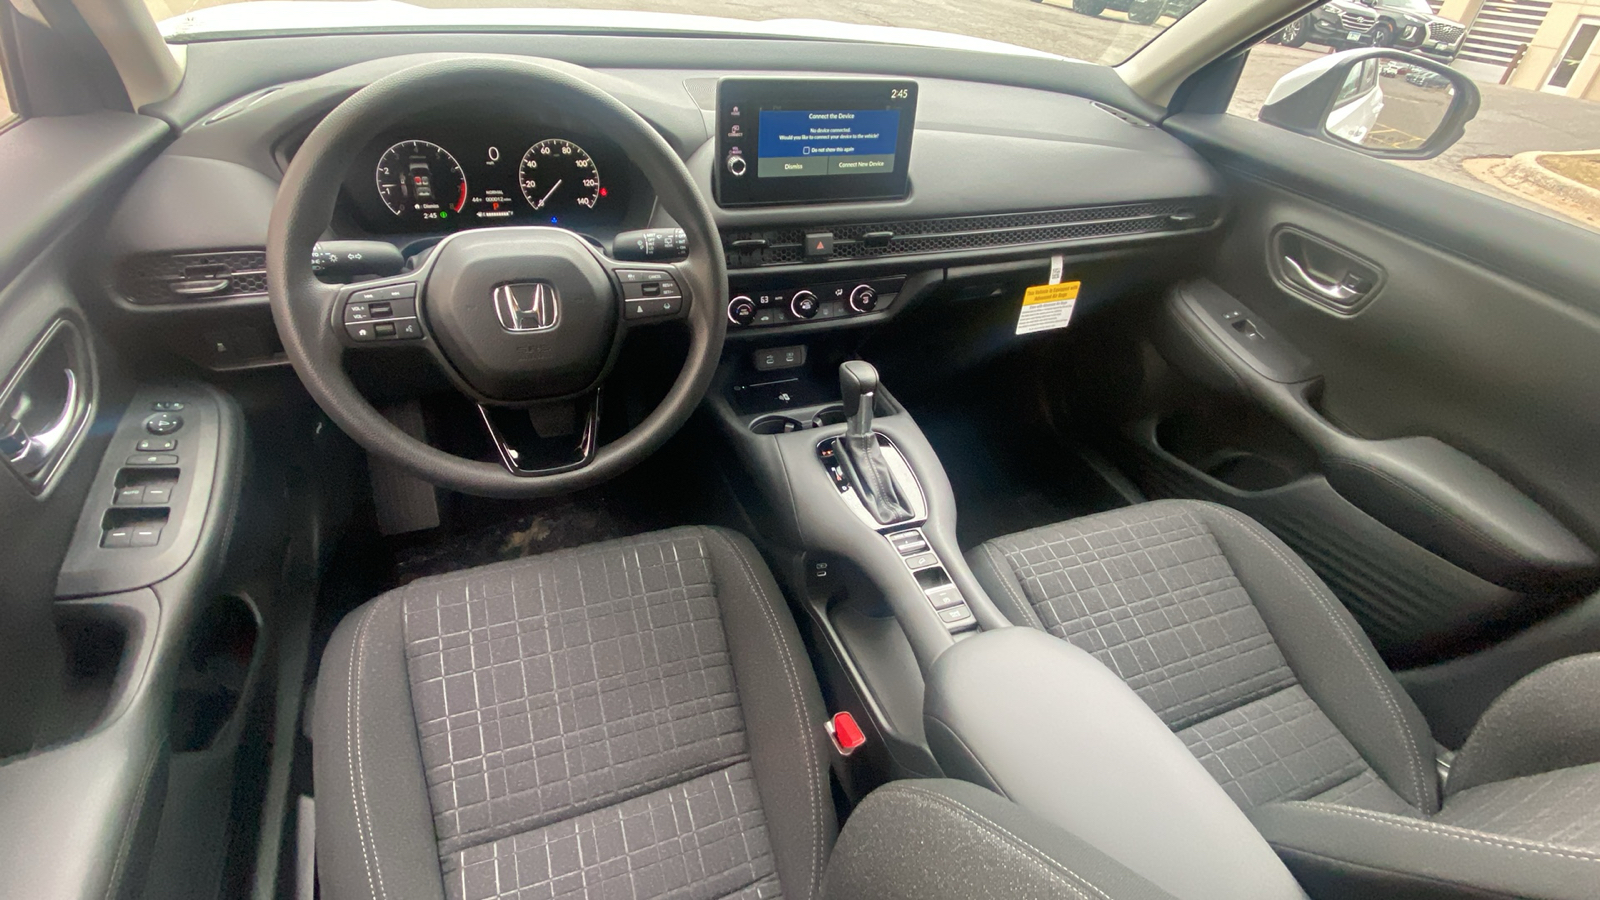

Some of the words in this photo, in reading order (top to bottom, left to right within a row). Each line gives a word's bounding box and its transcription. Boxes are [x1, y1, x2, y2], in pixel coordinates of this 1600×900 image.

[891, 89, 908, 98] 2:45
[488, 146, 500, 161] 0
[493, 202, 499, 210] P
